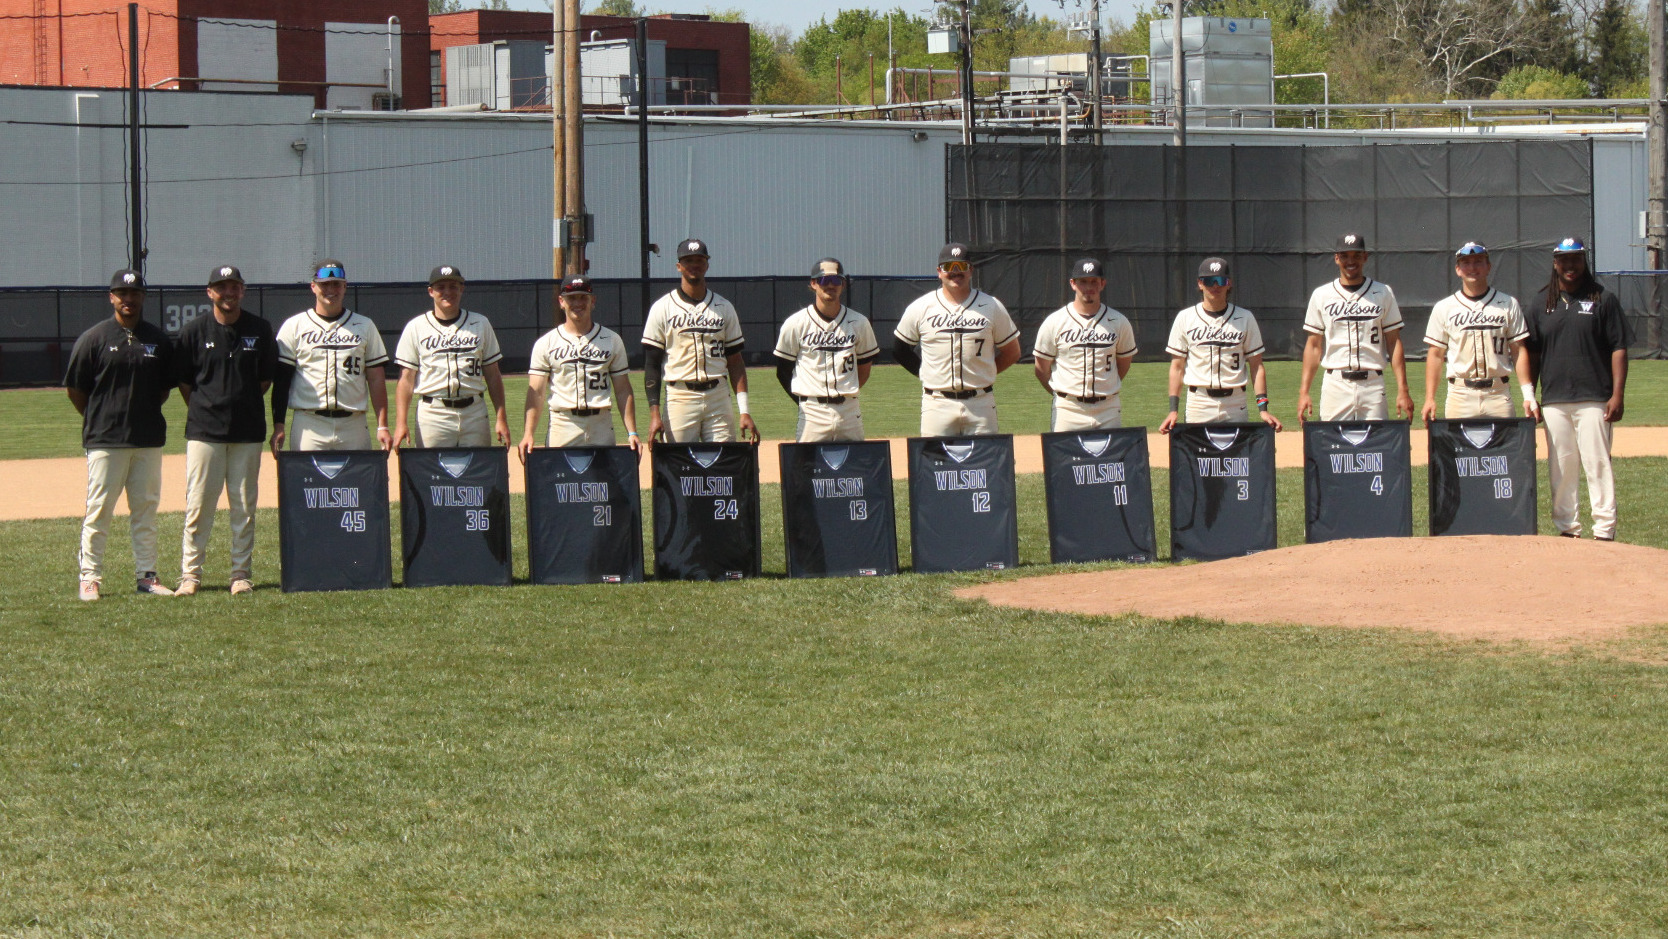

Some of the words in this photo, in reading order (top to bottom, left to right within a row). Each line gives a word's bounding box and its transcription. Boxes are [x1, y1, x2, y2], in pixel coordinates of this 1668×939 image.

[1325, 301, 1383, 317] Wilson
[1450, 310, 1506, 326] Wilson
[668, 313, 725, 330] Wilson
[927, 313, 989, 329] Wilson
[301, 327, 362, 345] Wilson
[420, 332, 481, 350] Wilson
[803, 330, 856, 347] Wilson
[1060, 327, 1117, 343] Wilson
[1187, 326, 1245, 341] Wilson
[1370, 326, 1380, 344] 2
[549, 343, 612, 360] Wilson
[974, 338, 985, 357] 7
[1492, 335, 1504, 355] 11
[343, 357, 362, 376] 45
[465, 357, 480, 377] 36
[842, 354, 855, 374] 19
[1105, 354, 1113, 372] 5
[1230, 353, 1240, 370] 3
[589, 371, 609, 390] 23
[1197, 457, 1249, 477] WILSON
[1330, 452, 1383, 473] WILSON
[1455, 456, 1508, 477] WILSON
[934, 469, 987, 490] WILSON
[1072, 461, 1125, 485] WILSON
[555, 482, 609, 503] WILSON
[680, 476, 733, 496] WILSON
[812, 477, 864, 498] WILSON
[1113, 485, 1127, 505] 11
[1237, 480, 1249, 500] 3
[1370, 475, 1383, 495] 4
[1493, 478, 1512, 498] 18
[304, 488, 359, 508] WILSON
[430, 486, 484, 506] WILSON
[972, 492, 991, 512] 12
[593, 505, 612, 526] 21
[714, 499, 739, 519] 24
[849, 500, 867, 520] 13
[340, 511, 366, 532] 45
[465, 510, 490, 531] 36
